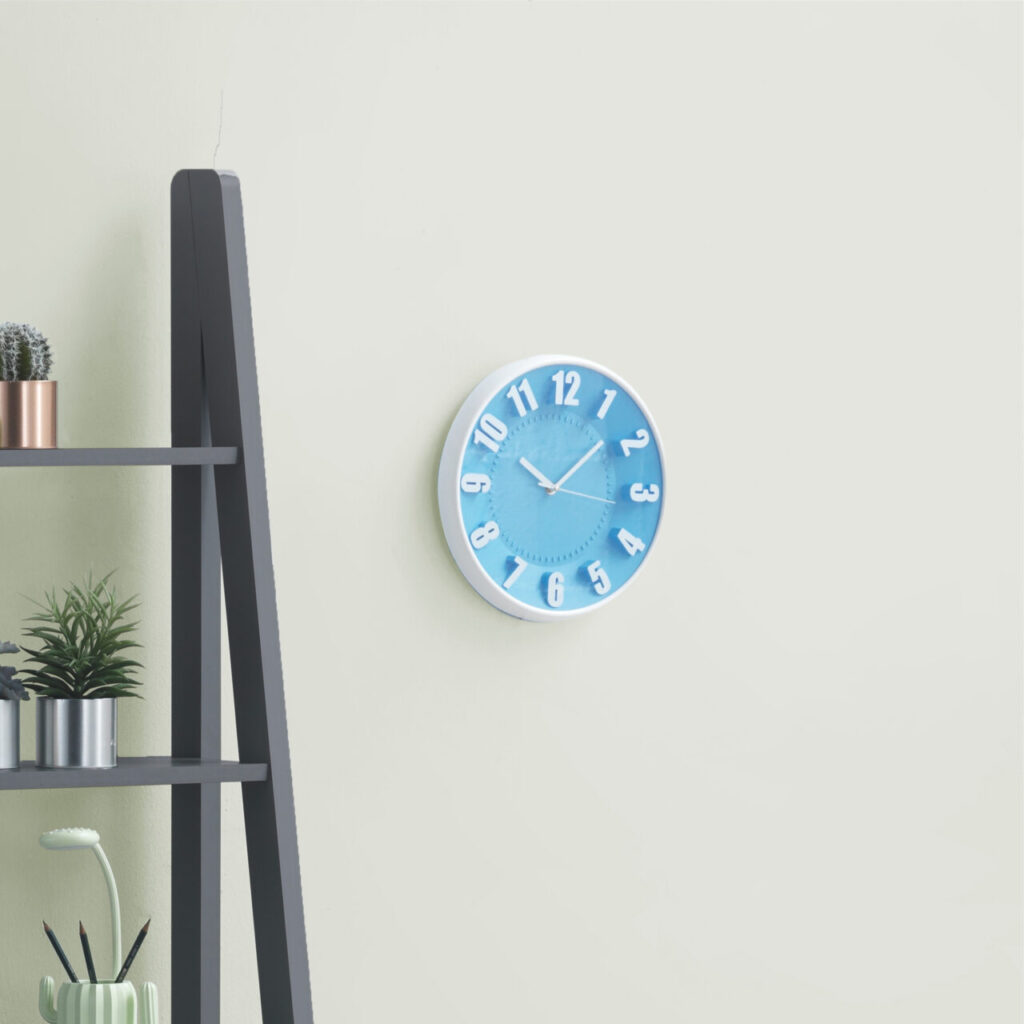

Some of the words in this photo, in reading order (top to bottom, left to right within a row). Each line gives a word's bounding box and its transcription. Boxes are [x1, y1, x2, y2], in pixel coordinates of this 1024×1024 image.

[506, 378, 539, 418] 11
[552, 370, 581, 406] 12
[596, 389, 618, 420] 1
[473, 413, 509, 453] 10
[620, 428, 650, 457] 2
[461, 473, 491, 494] 9
[629, 482, 660, 503] 3
[470, 520, 500, 549] 8
[617, 527, 646, 557] 4
[503, 556, 528, 590] 7
[587, 560, 611, 595] 5
[547, 571, 564, 608] 6
